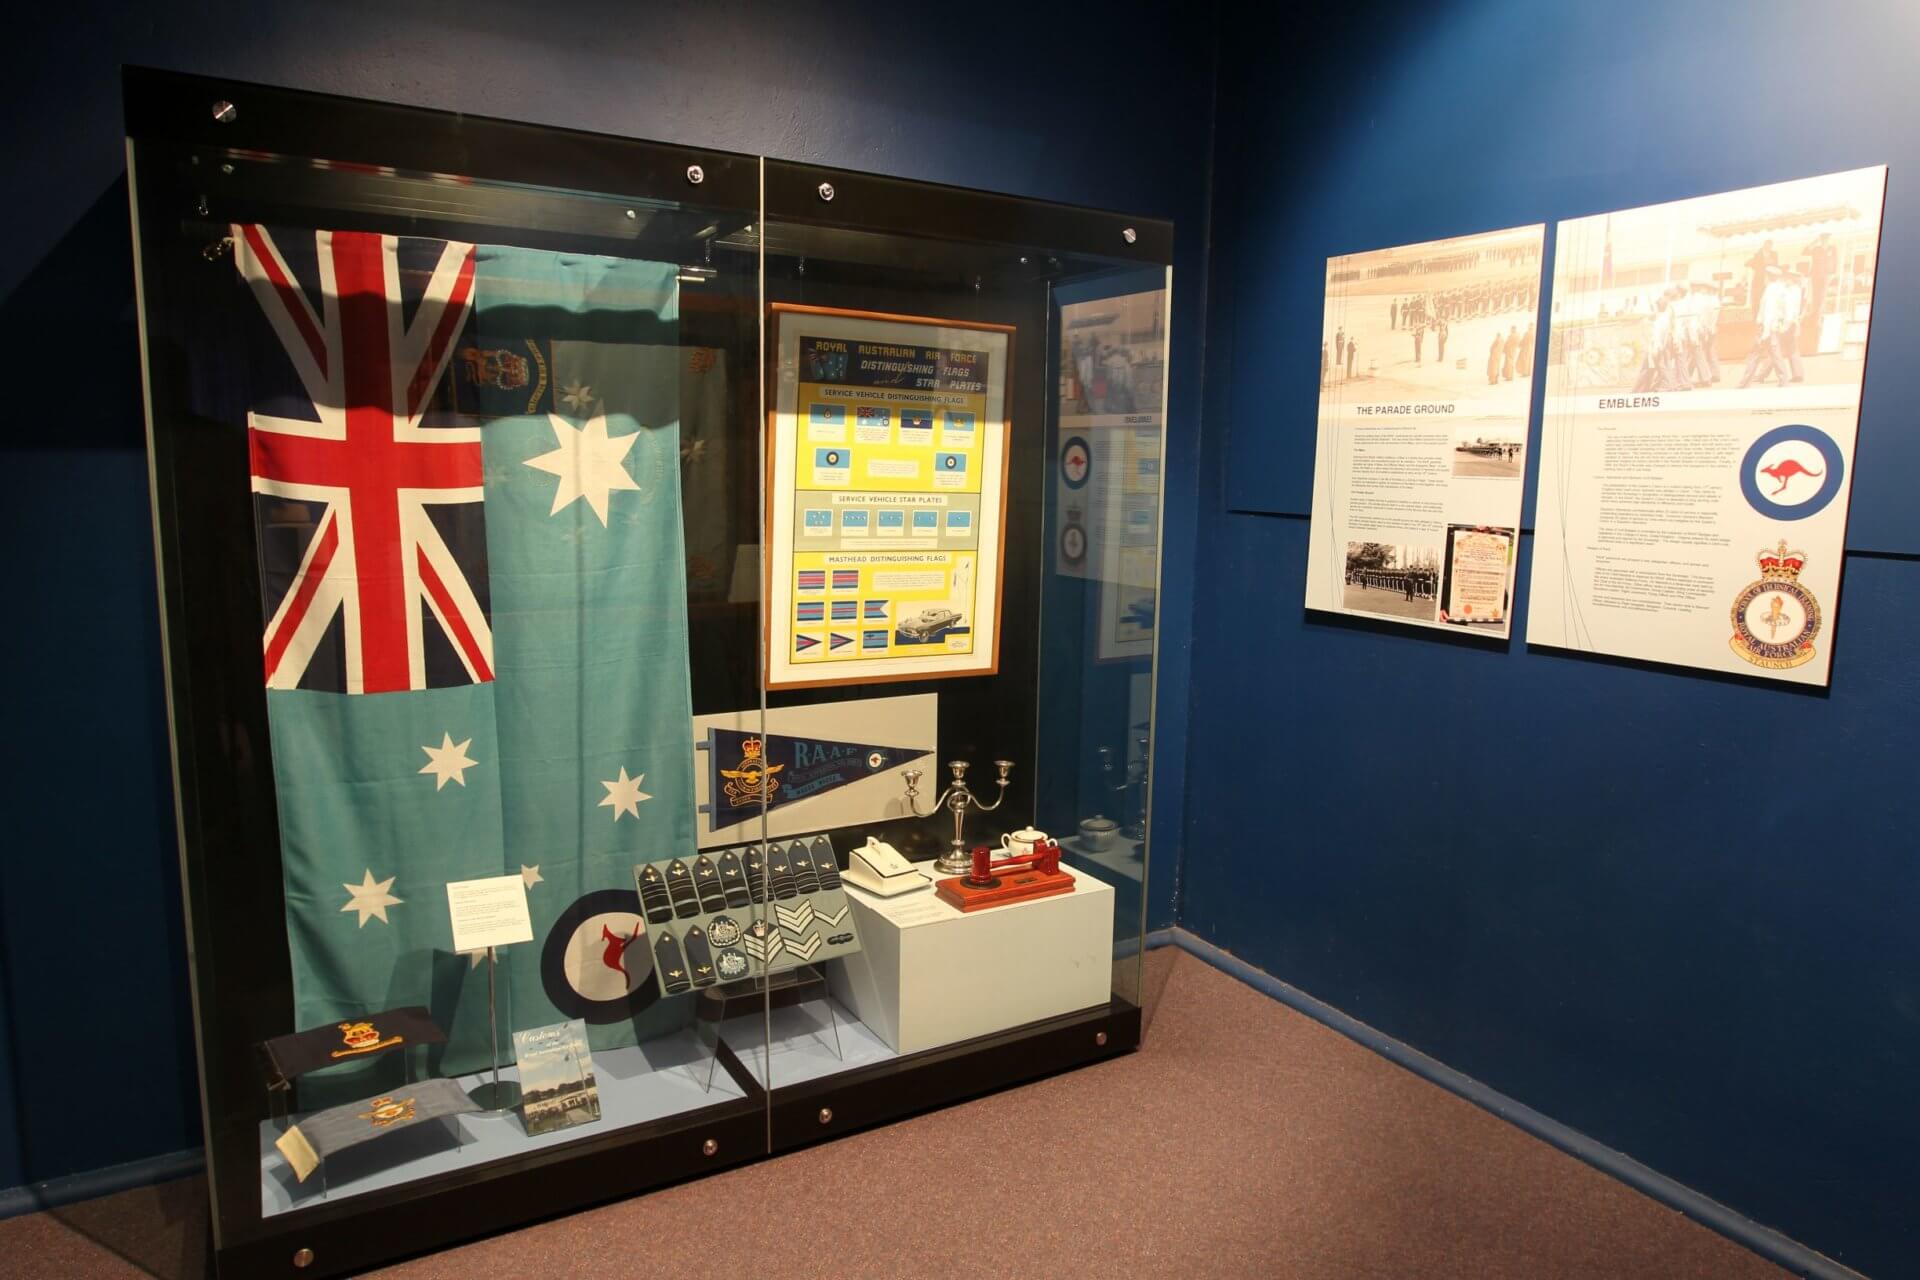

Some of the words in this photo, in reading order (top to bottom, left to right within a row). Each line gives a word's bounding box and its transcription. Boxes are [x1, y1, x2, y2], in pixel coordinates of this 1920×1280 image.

[816, 341, 847, 353] ROYAL
[858, 344, 916, 358] AUSTRALIAN
[925, 350, 941, 360] AIR
[951, 352, 977, 364] FORCE
[861, 360, 934, 375] DISTINGUISHING
[943, 367, 970, 377] FLAGS
[915, 378, 940, 388] STAR
[950, 380, 982, 391] PLATES
[824, 389, 855, 397] SERVICE
[856, 391, 885, 399] VEHICLE
[887, 393, 941, 402] DISTINGUISHING
[1598, 396, 1660, 409] EMBLEMS
[1356, 405, 1373, 415] THE
[1375, 404, 1412, 415] PARADE
[1414, 404, 1455, 414] GROUND
[838, 495, 866, 503] SERVICE
[869, 495, 897, 503] VEHICLE
[899, 496, 917, 504] STAR
[918, 496, 942, 504] PLATES
[829, 555, 868, 563] MASTHEAD
[870, 555, 925, 563] DISTINGUISHING
[926, 554, 946, 562] FLAGS
[1758, 629, 1811, 653] AUSTRALIAN
[1764, 650, 1793, 658] FORCE
